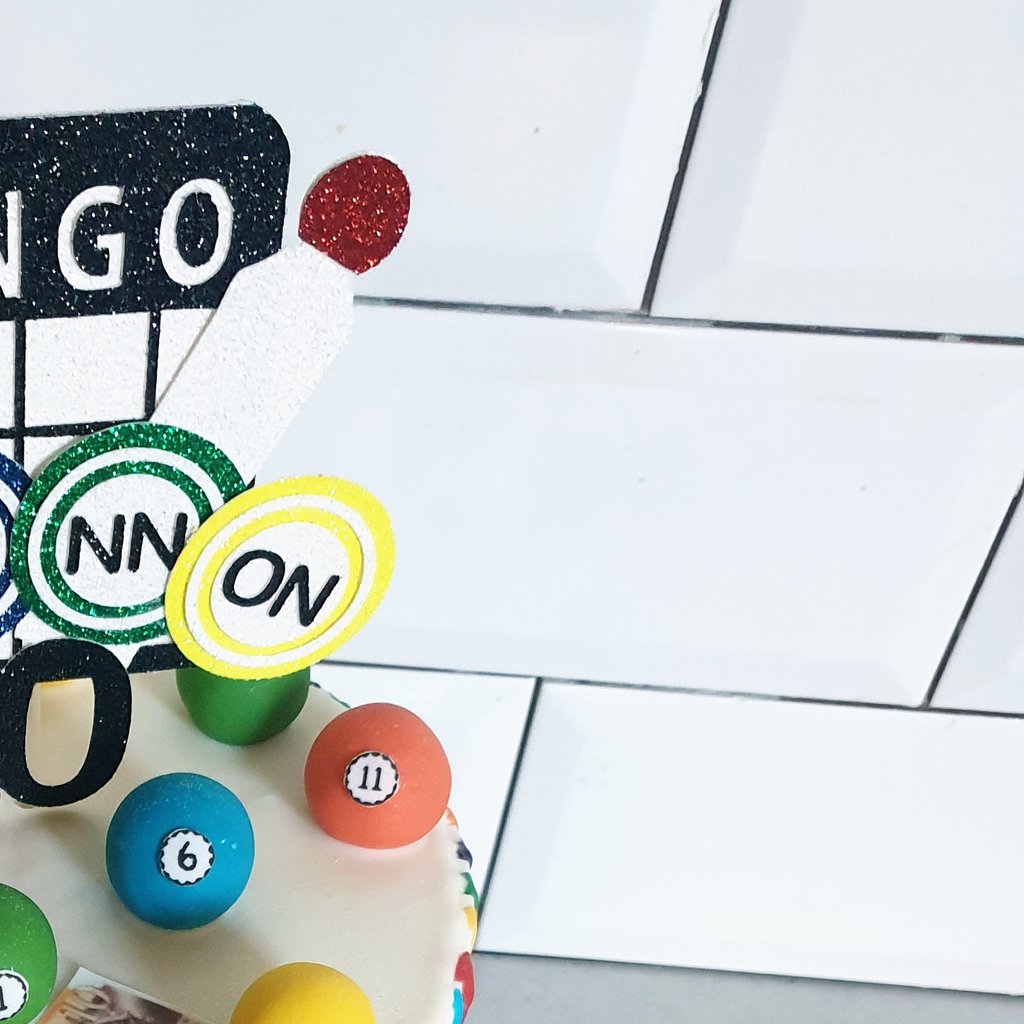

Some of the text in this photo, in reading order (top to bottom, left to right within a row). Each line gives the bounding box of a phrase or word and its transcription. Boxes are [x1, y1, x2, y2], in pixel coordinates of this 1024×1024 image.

[66, 510, 198, 576] NN
[222, 547, 340, 628] ON
[359, 766, 383, 791] 11
[179, 844, 195, 869] 6
